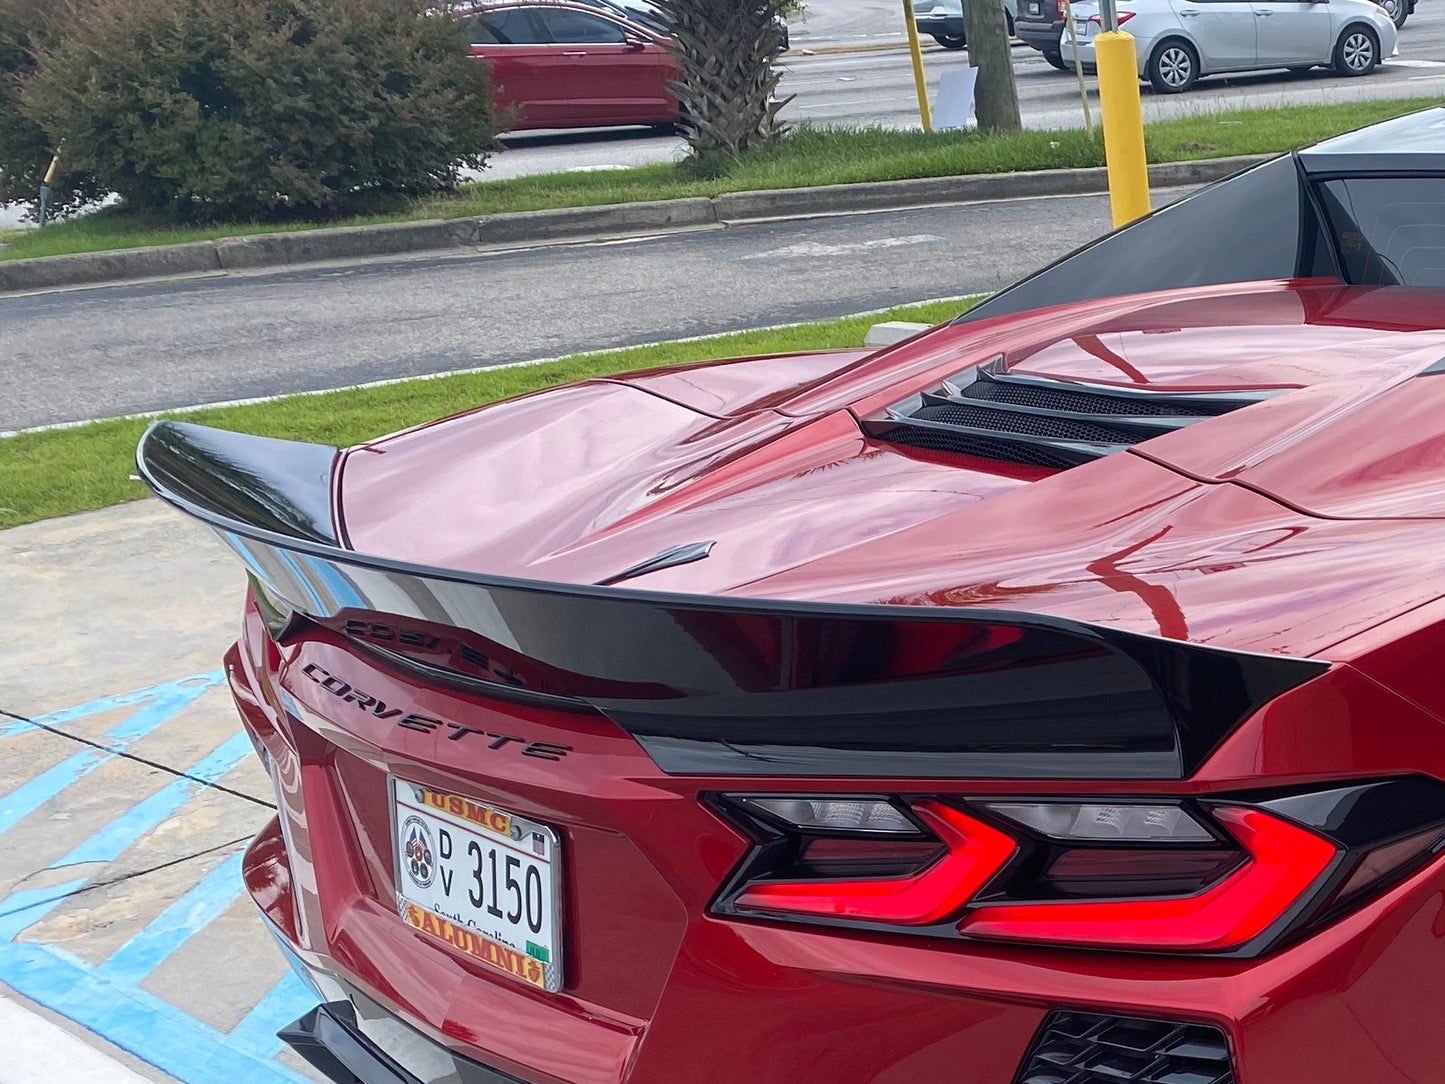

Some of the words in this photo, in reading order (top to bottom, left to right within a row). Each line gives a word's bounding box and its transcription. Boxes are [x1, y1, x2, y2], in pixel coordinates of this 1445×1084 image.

[302, 662, 573, 761] CORVETTE
[431, 793, 506, 833] USMC
[468, 841, 542, 934] 3150
[422, 914, 527, 979] ALUMNI
